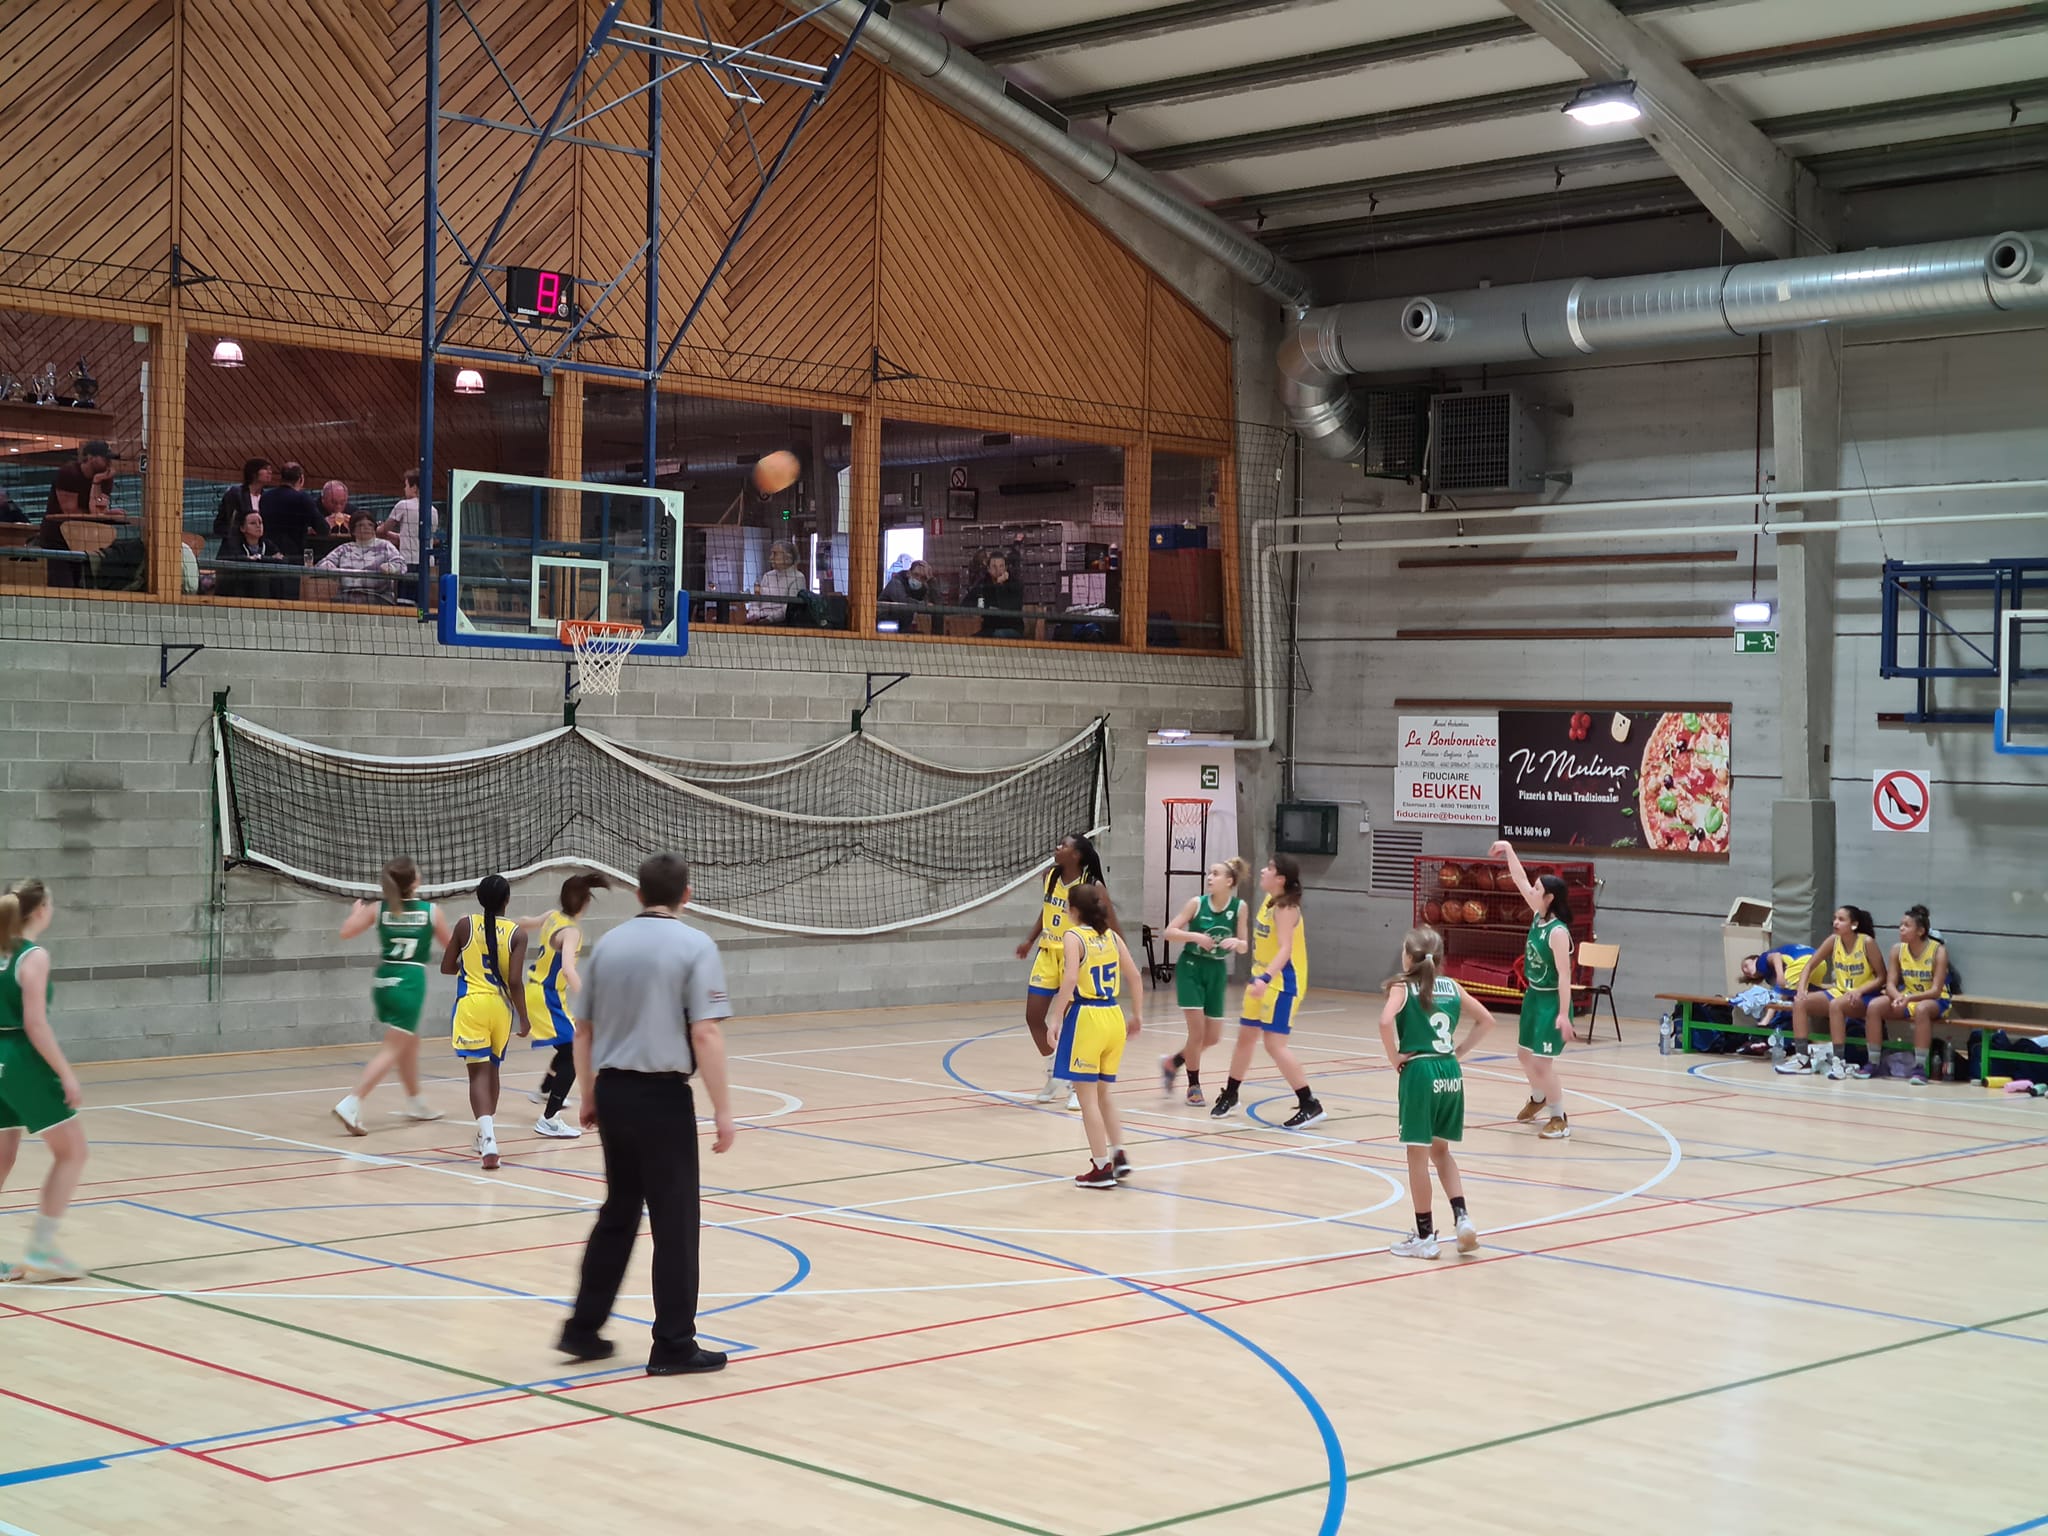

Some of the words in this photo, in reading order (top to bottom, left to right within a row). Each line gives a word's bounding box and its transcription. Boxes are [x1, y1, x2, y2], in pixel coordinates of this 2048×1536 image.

[536, 271, 560, 315] 8
[1405, 730, 1422, 748] La
[1427, 730, 1498, 747] Bonbonnière
[1422, 772, 1470, 781] FIDUCIAIRE
[1412, 783, 1482, 801] BEUKEN
[1518, 789, 1546, 801] Pizzeria
[1547, 790, 1553, 801] &
[1554, 791, 1573, 802] Pasta
[1456, 803, 1490, 811] THIMISTER
[1396, 810, 1497, 822] fiduciaire@beuken.be
[1052, 914, 1062, 927] 6
[1090, 961, 1118, 1000] 15
[1429, 1011, 1453, 1054] 3
